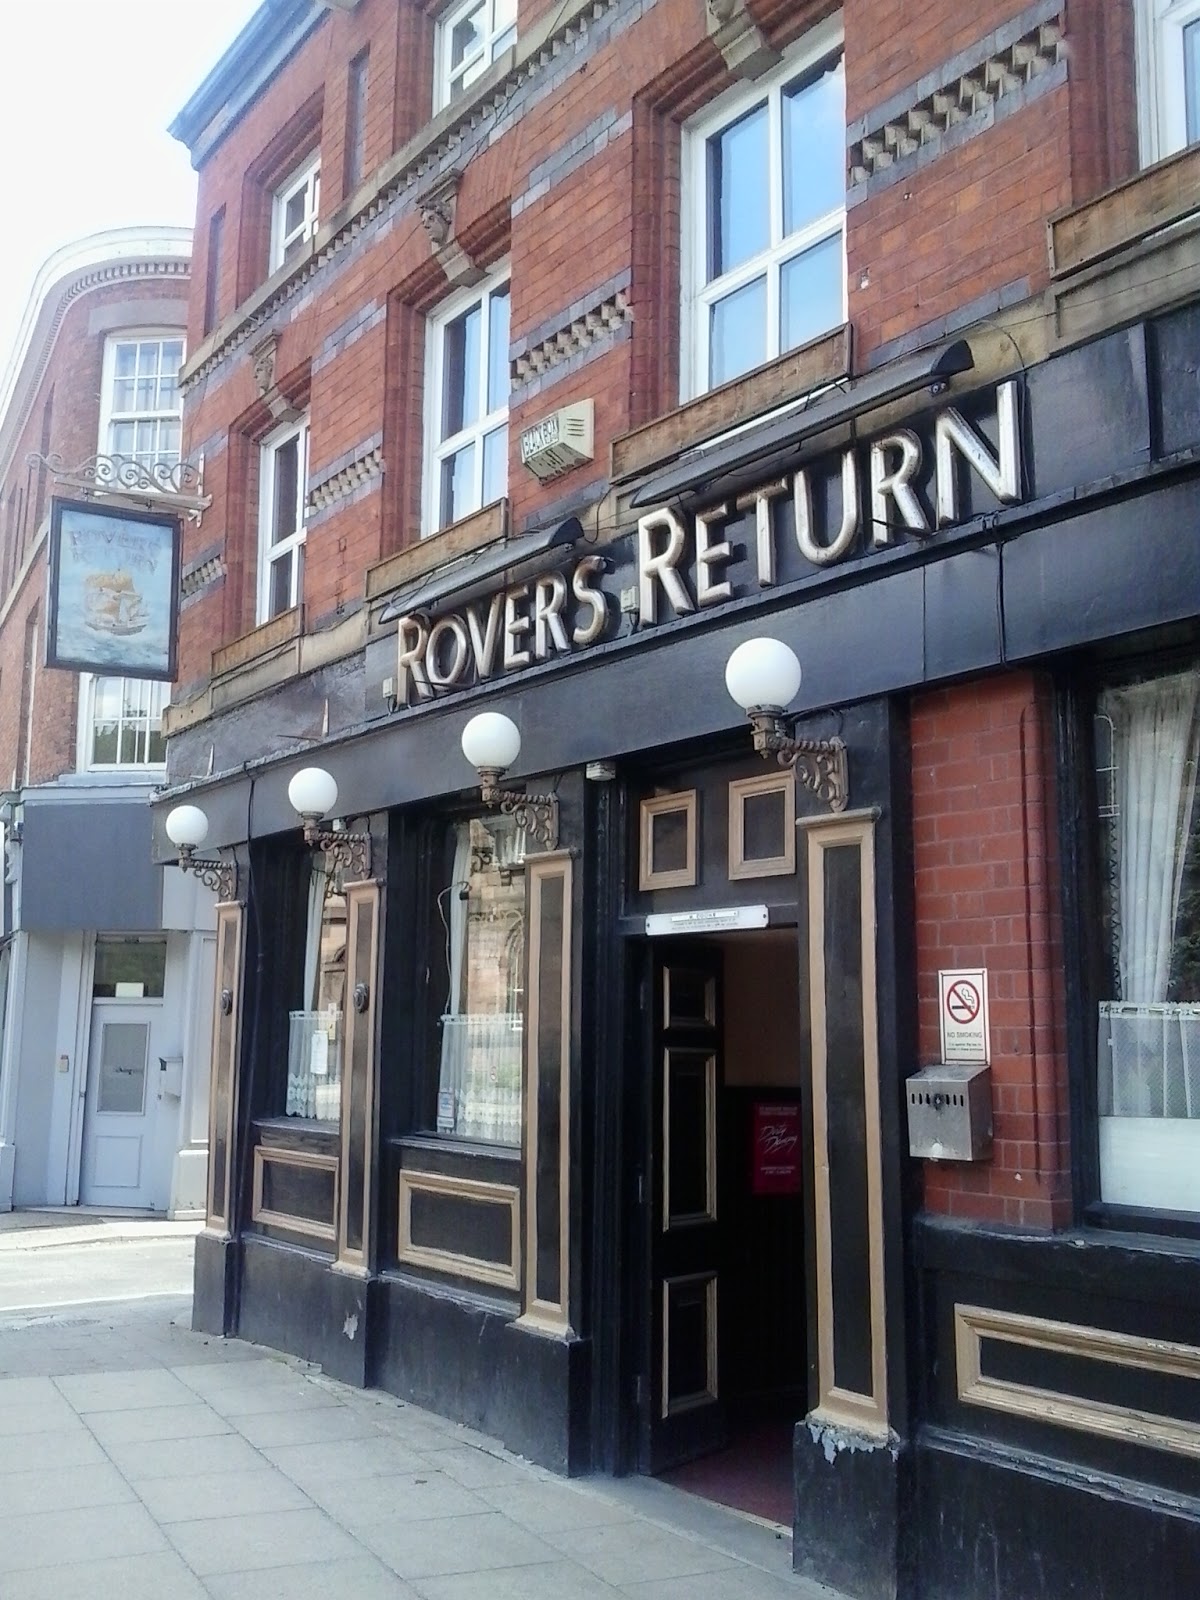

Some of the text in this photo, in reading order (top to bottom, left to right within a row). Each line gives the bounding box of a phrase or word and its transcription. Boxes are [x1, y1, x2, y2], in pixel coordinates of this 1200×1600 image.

[398, 379, 1023, 703] ROVERS RETURN
[947, 1031, 983, 1039] NO SMOKING
